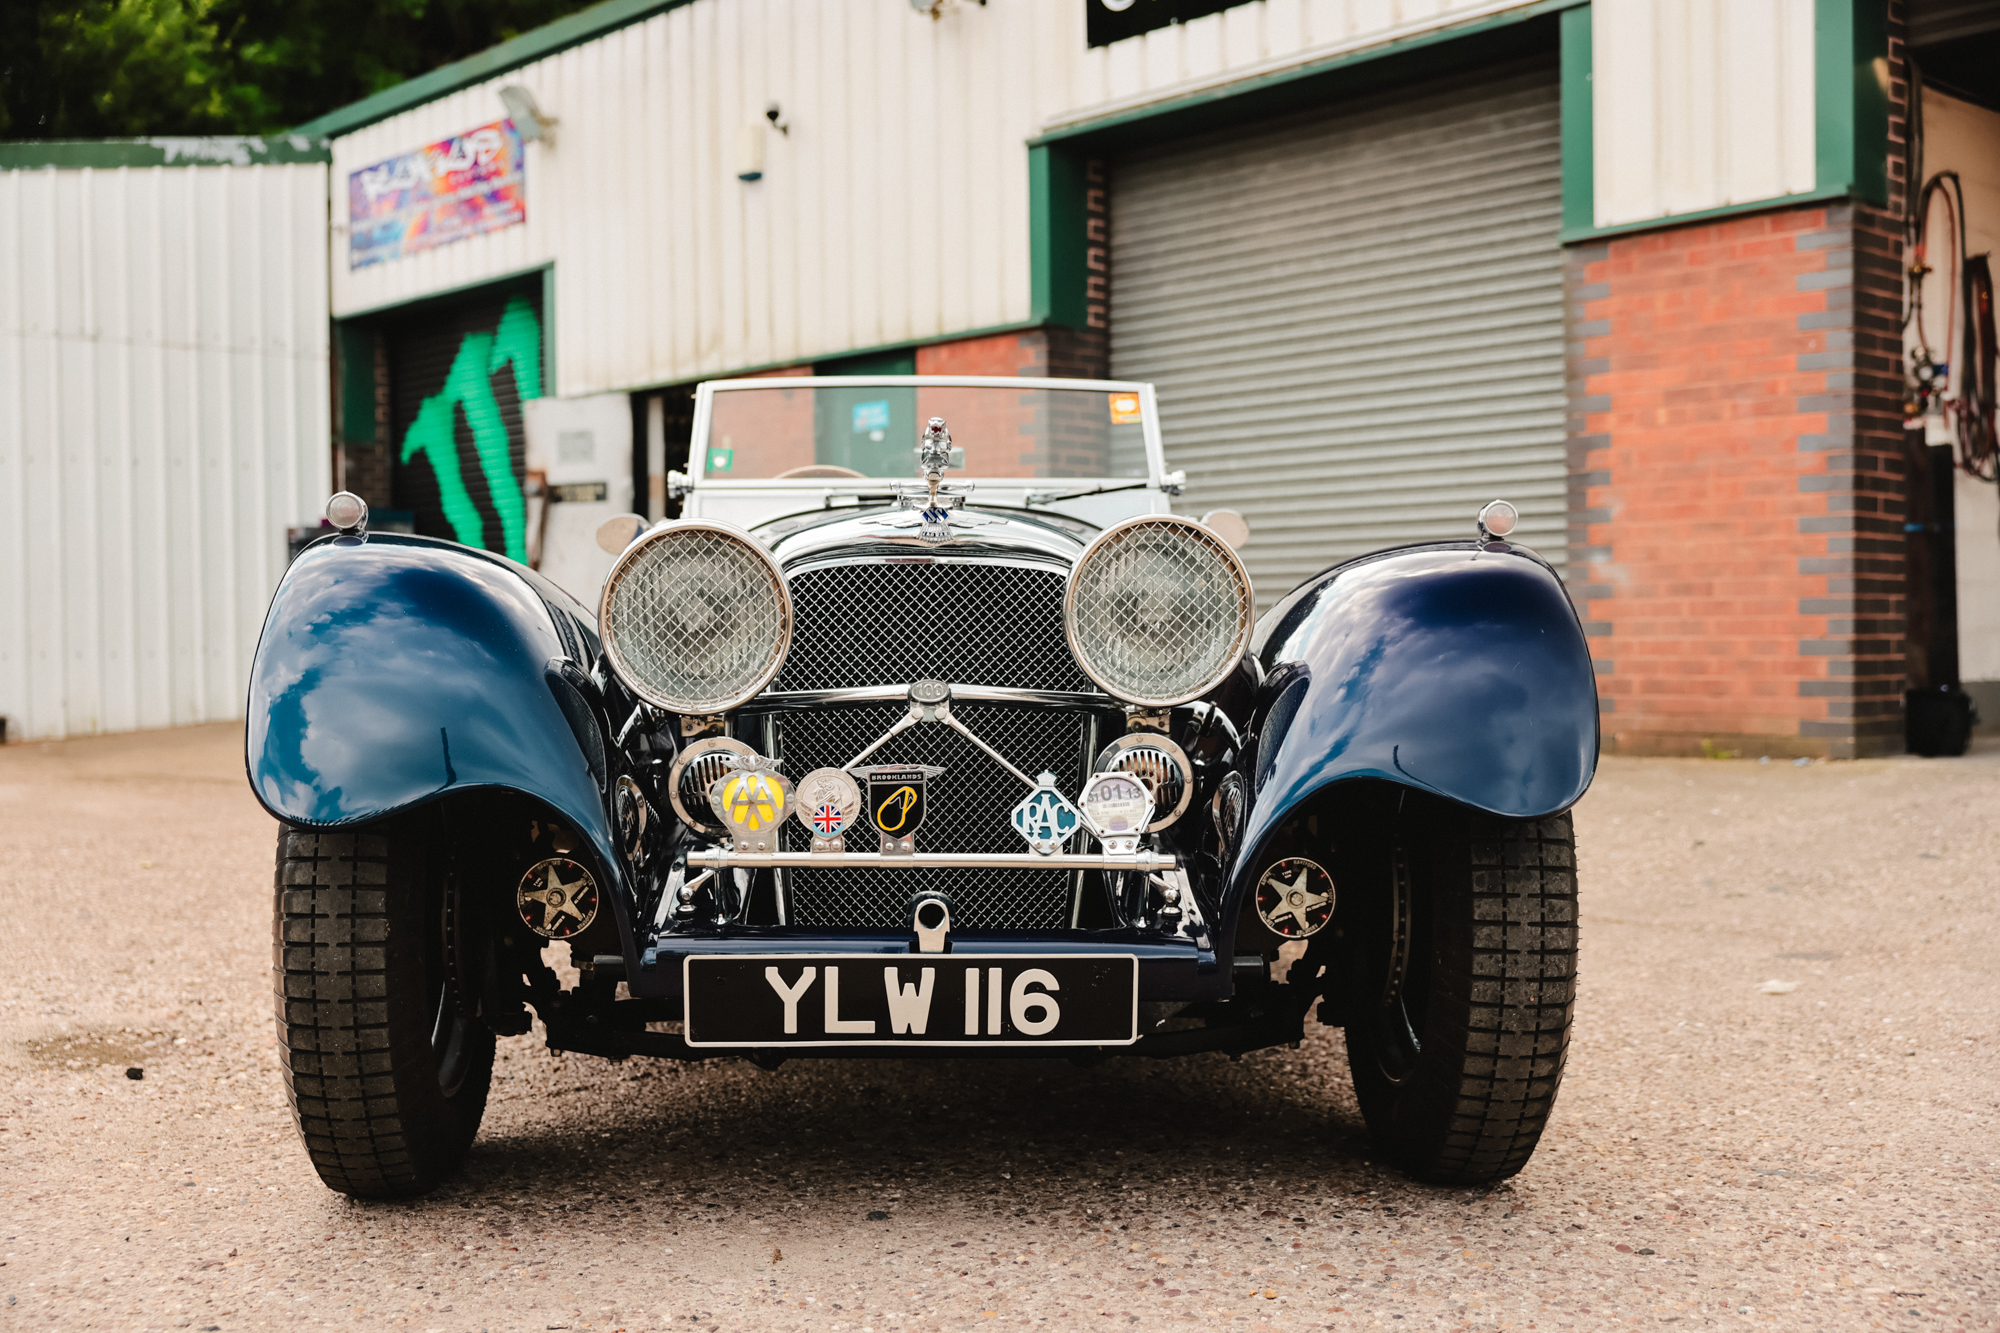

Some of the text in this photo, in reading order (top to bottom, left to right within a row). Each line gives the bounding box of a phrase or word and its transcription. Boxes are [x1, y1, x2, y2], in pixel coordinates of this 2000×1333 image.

[915, 683, 944, 697] 100
[1088, 784, 1140, 802] 31 01 13
[1022, 793, 1070, 840] RAC
[964, 966, 1061, 1036] 116
